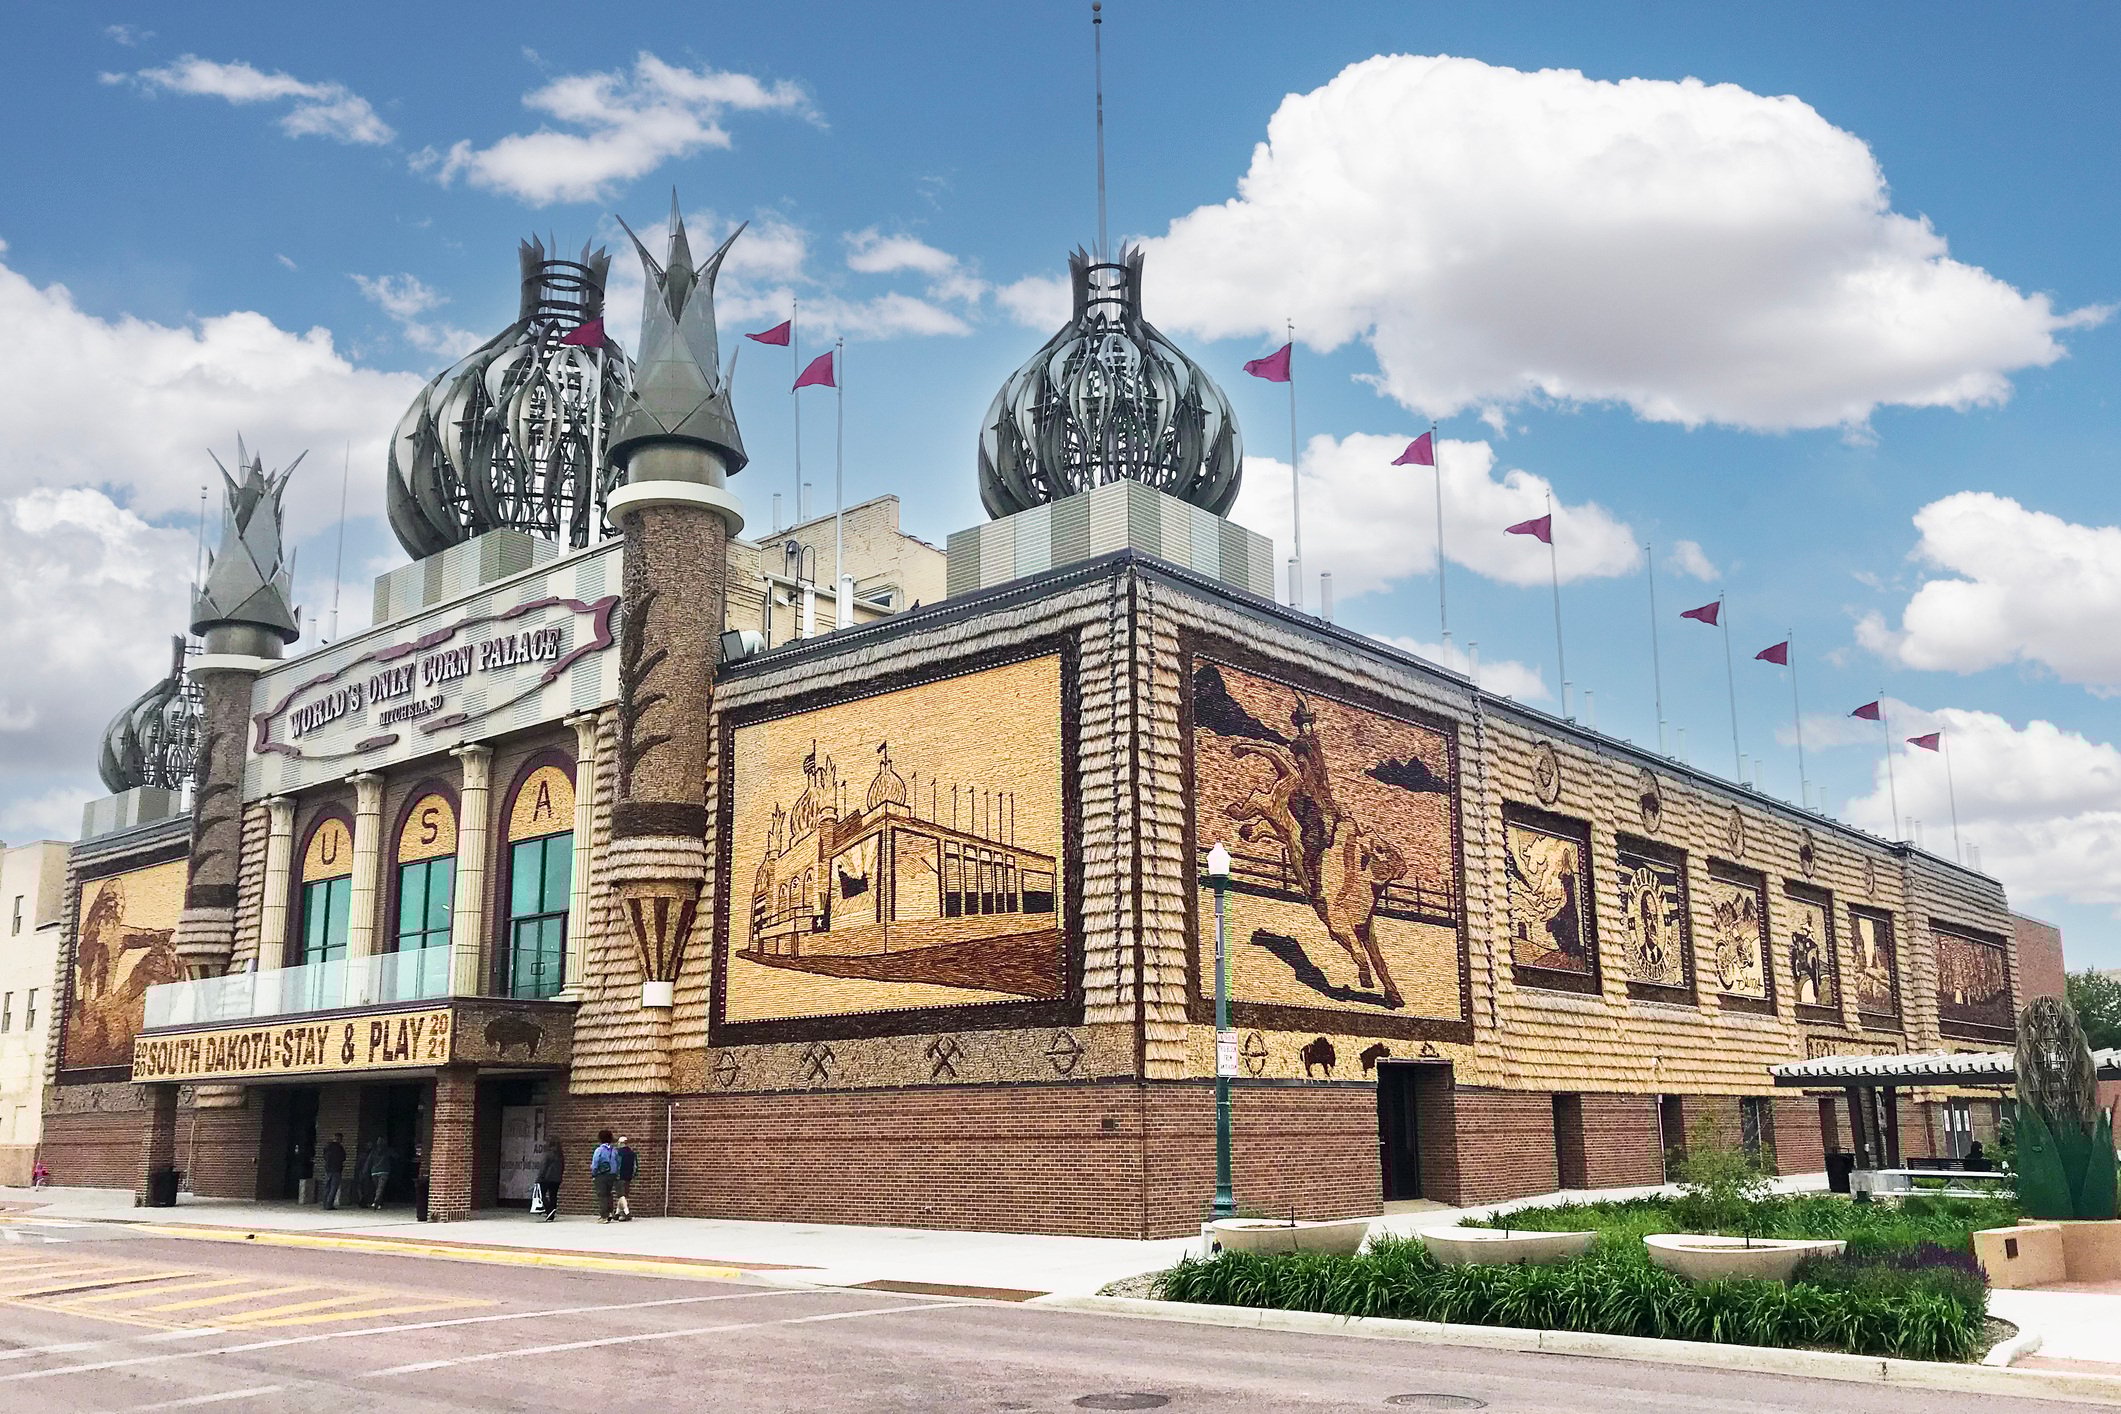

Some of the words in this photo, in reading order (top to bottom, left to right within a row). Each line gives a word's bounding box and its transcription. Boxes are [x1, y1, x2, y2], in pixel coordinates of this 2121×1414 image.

[290, 682, 361, 739] WORLD'S
[369, 662, 415, 704] ONLY
[421, 644, 473, 687] CORN
[477, 627, 561, 671] PALACE
[321, 829, 339, 865] U
[420, 807, 439, 845] S
[533, 780, 551, 821] A
[430, 1013, 449, 1036] 20
[135, 1041, 148, 1059] 20
[147, 1038, 202, 1076] SOUTH
[282, 1025, 330, 1068] STAY
[341, 1023, 355, 1064] &
[368, 1016, 425, 1063] PLAY
[427, 1037, 446, 1059] 21
